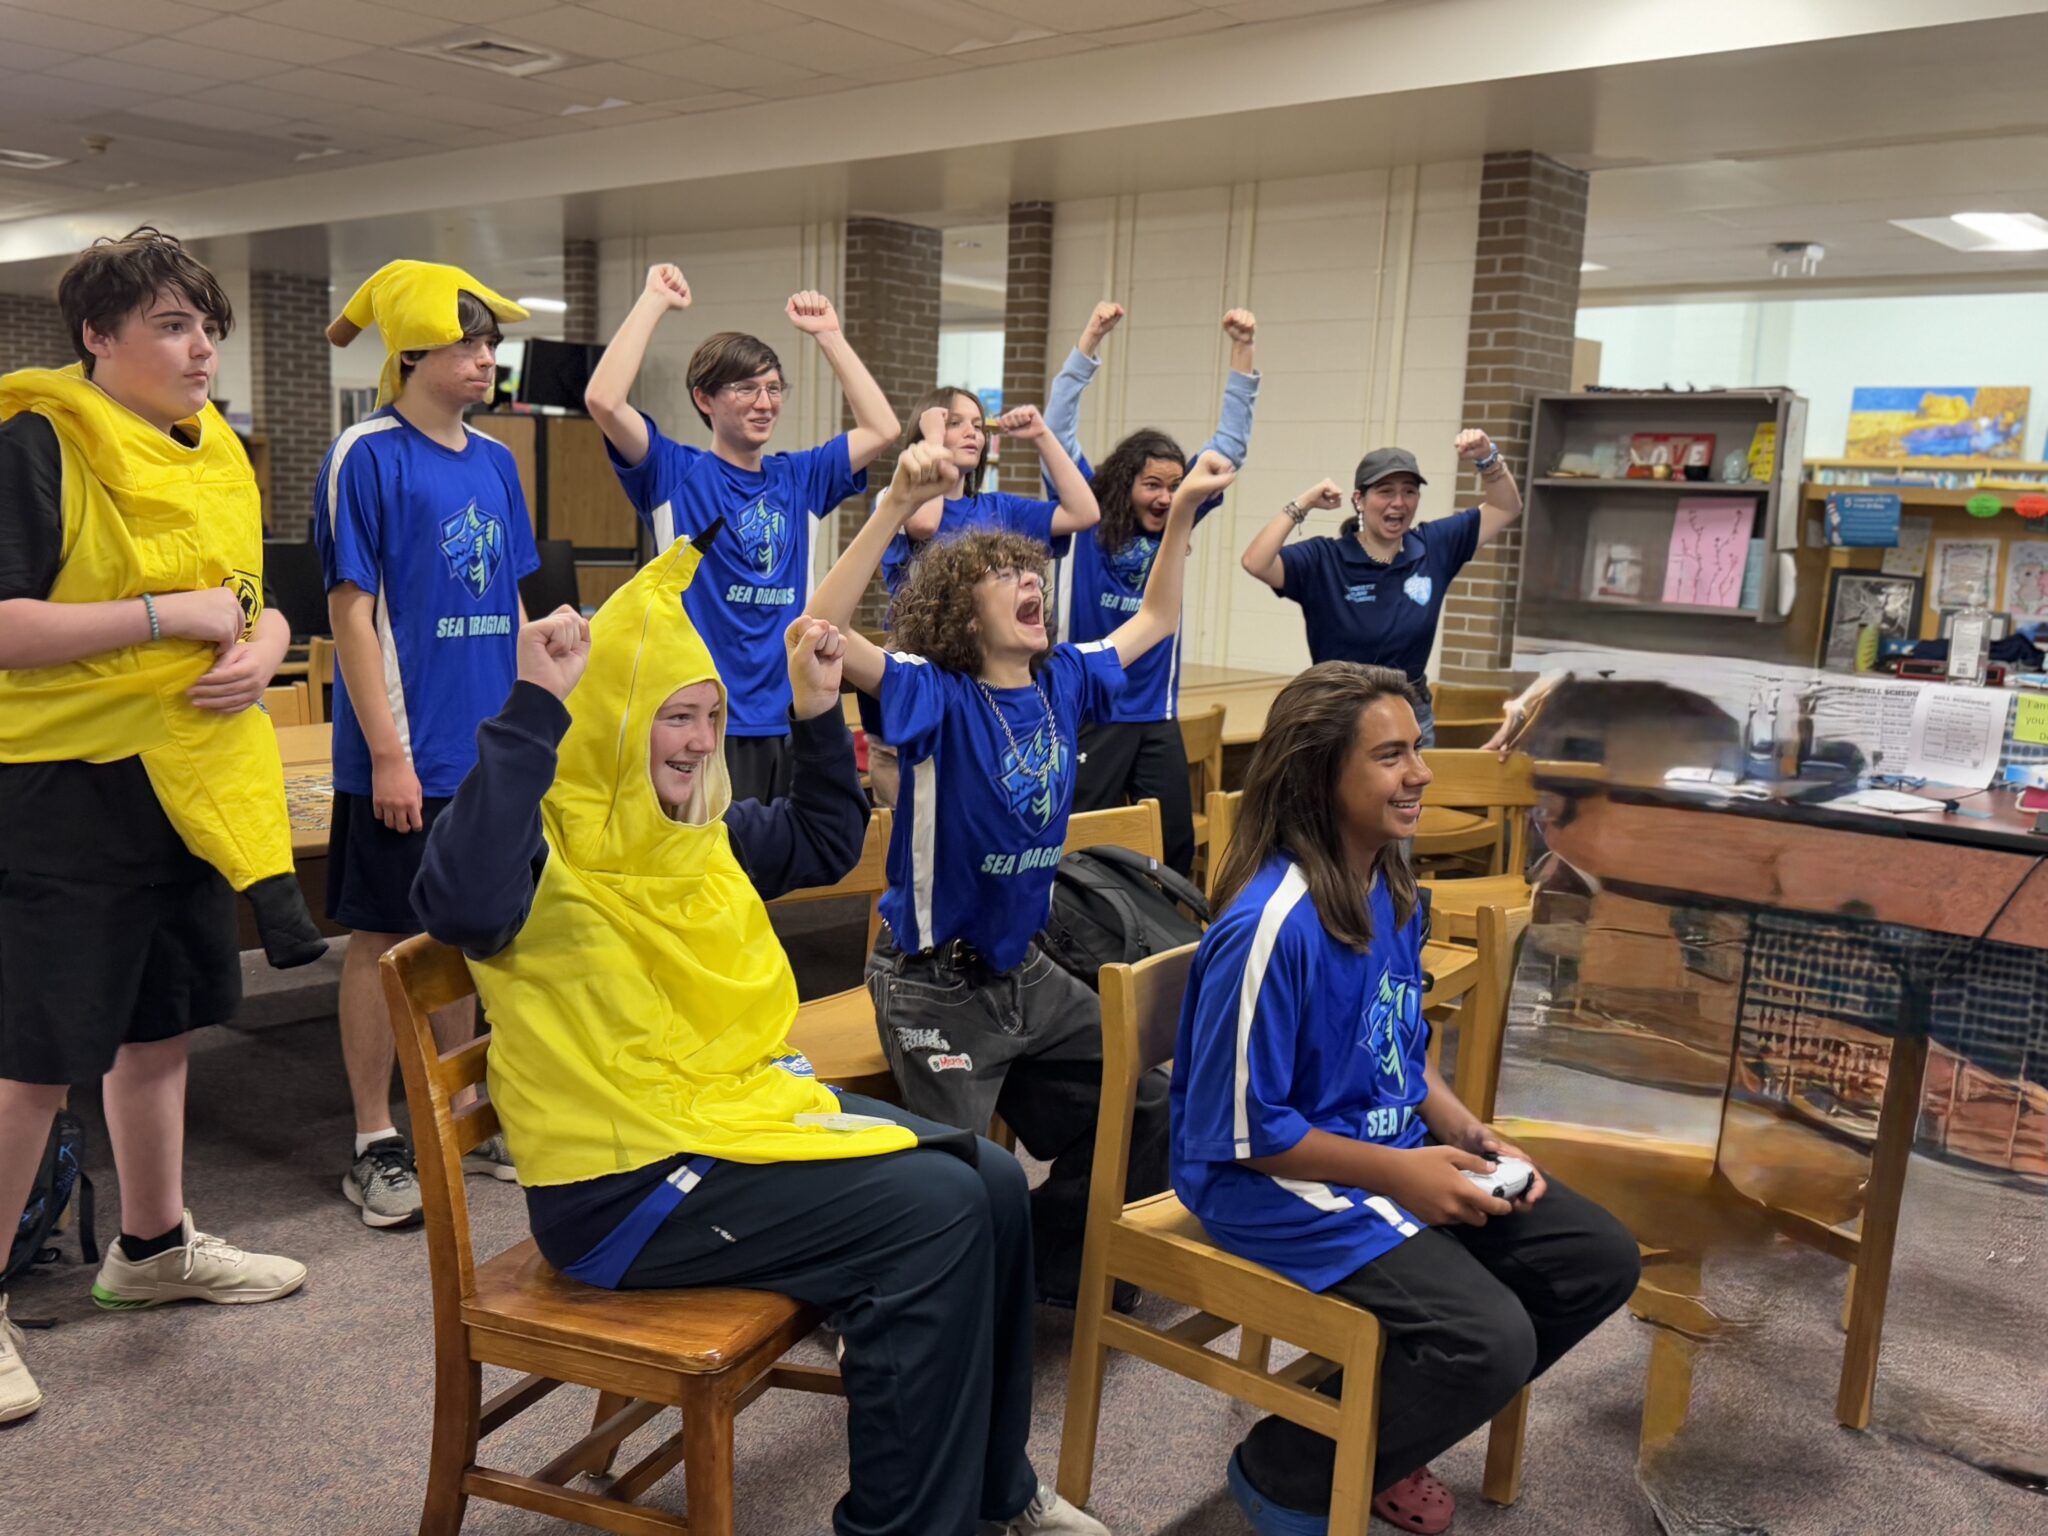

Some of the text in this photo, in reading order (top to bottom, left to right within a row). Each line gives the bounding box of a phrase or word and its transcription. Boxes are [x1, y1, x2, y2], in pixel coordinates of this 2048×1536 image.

[726, 585, 795, 605] SEA DRAGS
[1100, 592, 1120, 609] SEA
[437, 617, 465, 638] SEA
[981, 854, 1016, 875] SEA
[1367, 1107, 1398, 1138] SEA
